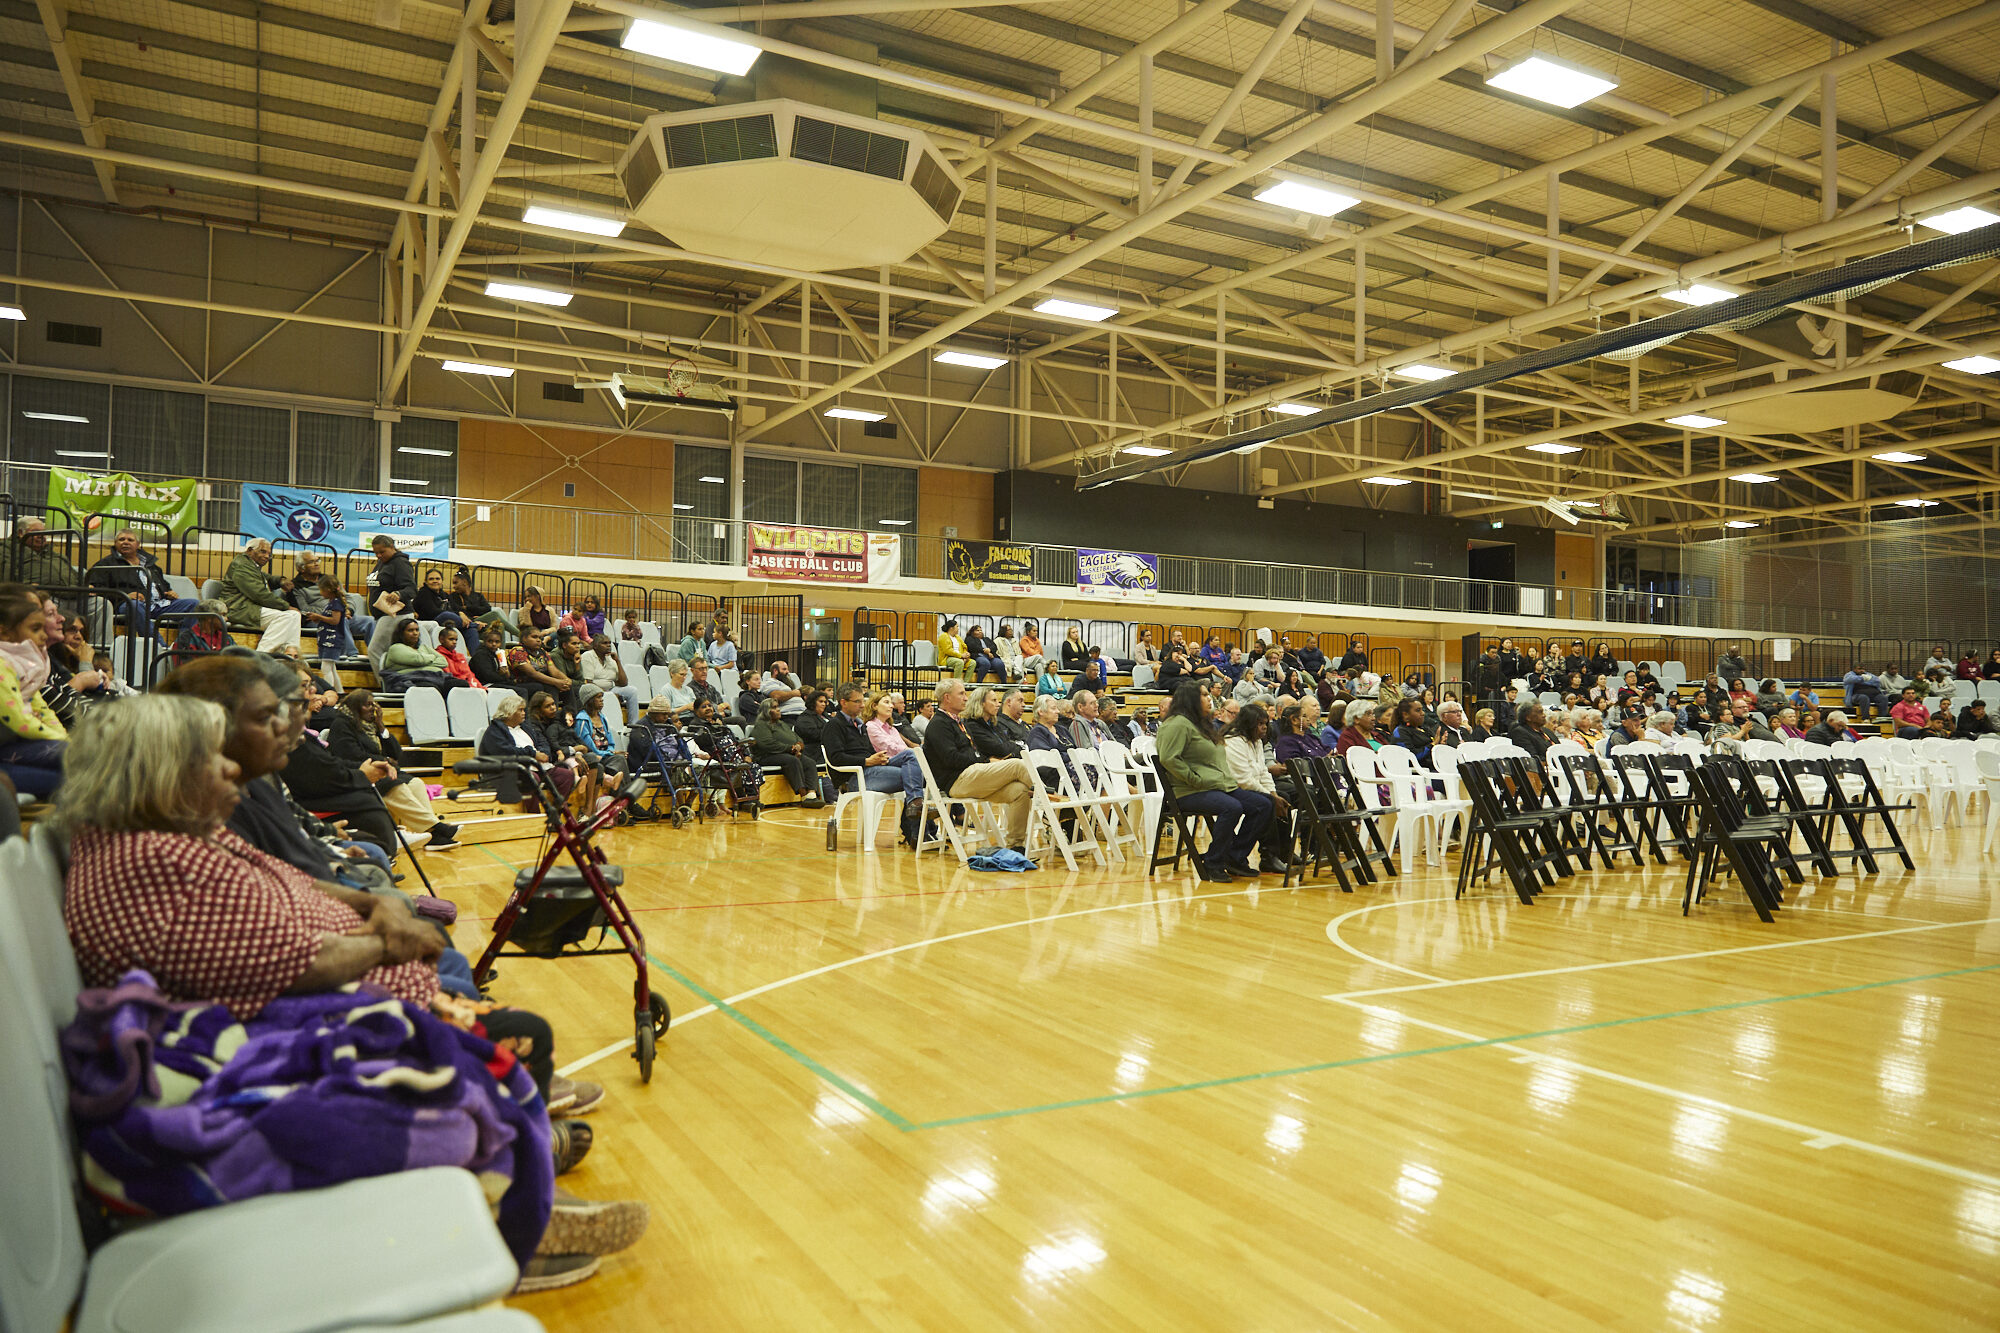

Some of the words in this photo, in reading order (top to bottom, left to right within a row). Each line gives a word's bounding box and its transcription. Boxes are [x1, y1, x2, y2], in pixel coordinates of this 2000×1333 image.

[64, 477, 182, 502] MATRIX
[112, 508, 180, 521] Basketball
[311, 493, 345, 531] TITANS
[355, 501, 439, 516] BASKETBALL
[129, 522, 160, 531] Club
[380, 515, 415, 528] CLUB
[752, 526, 865, 554] WILDCATS
[752, 555, 829, 571] BASKETBALL
[832, 559, 863, 572] CLUB
[988, 546, 1031, 568] FALCONS
[1080, 553, 1118, 568] EAGLES
[1082, 565, 1116, 575] BASKETBALL
[1091, 572, 1106, 580] CLUB
